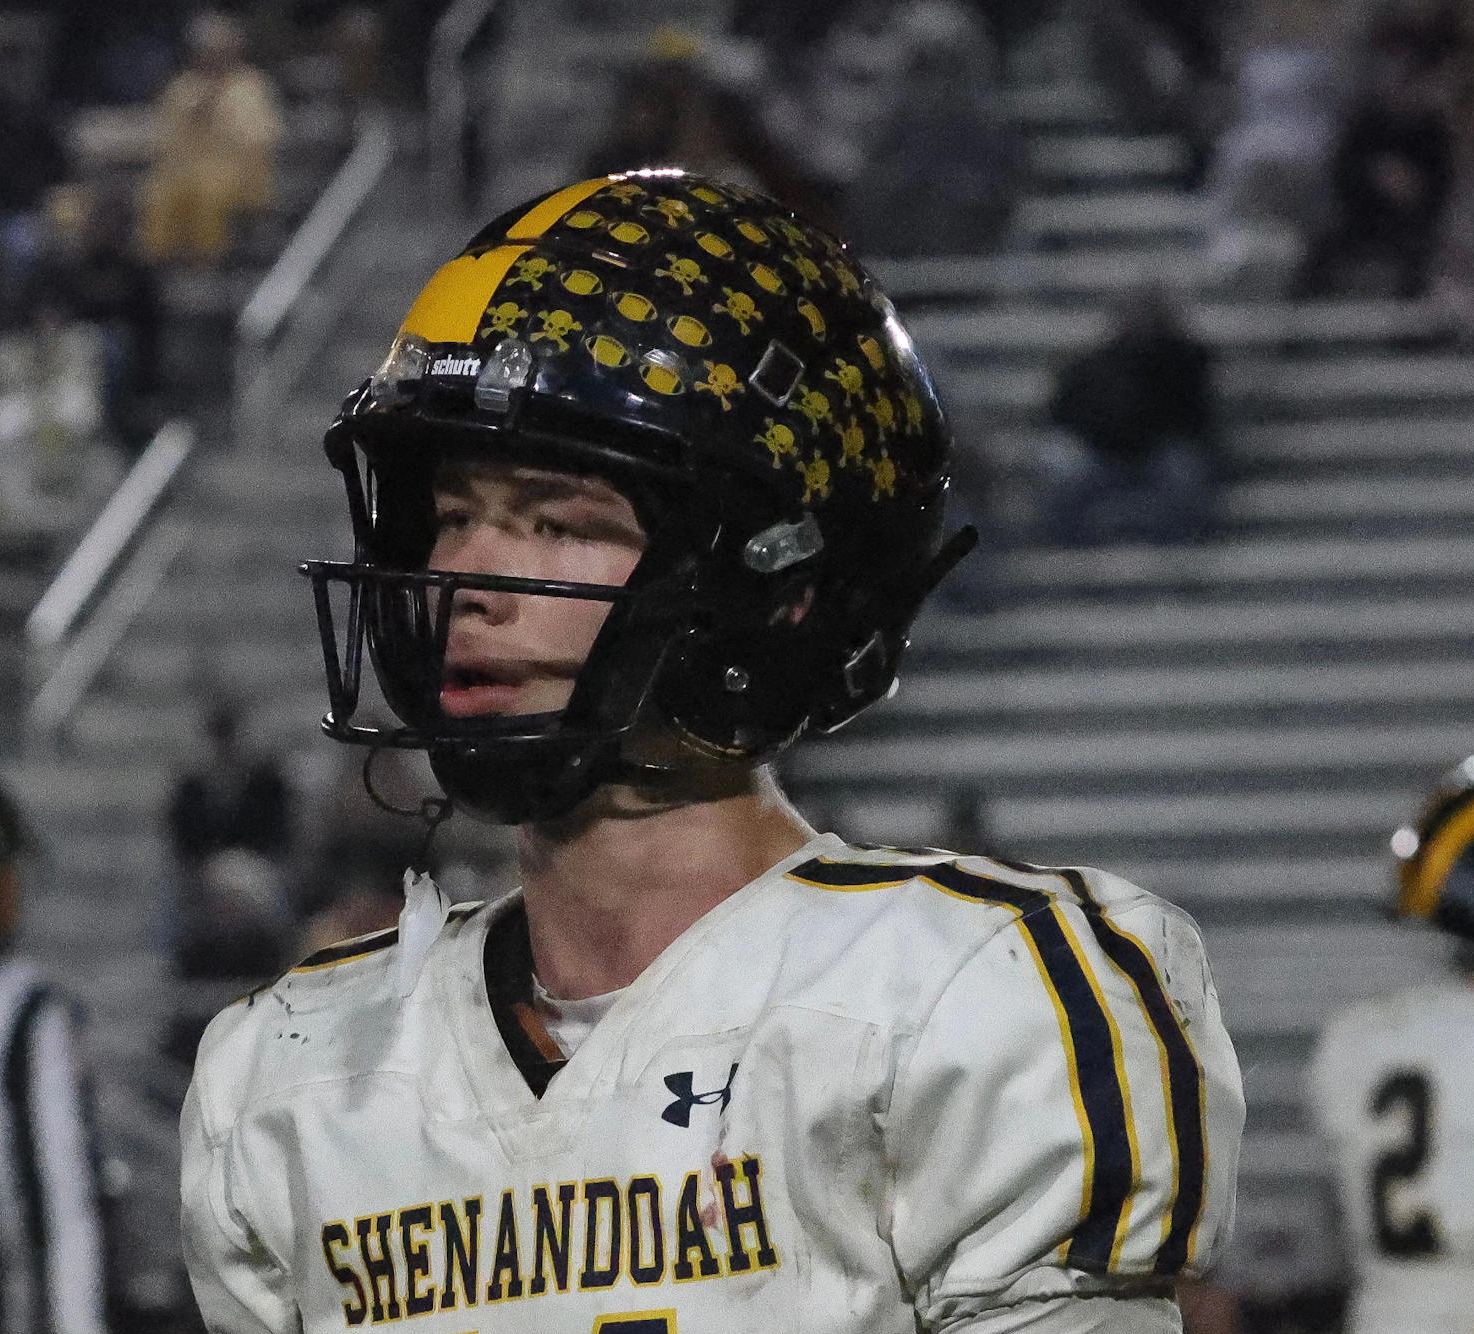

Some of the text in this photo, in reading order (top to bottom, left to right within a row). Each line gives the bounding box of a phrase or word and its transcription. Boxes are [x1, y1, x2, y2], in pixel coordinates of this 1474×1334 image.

[430, 353, 482, 377] schutt
[321, 1154, 780, 1327] SHENANDOAH
[1368, 1066, 1445, 1260] 2
